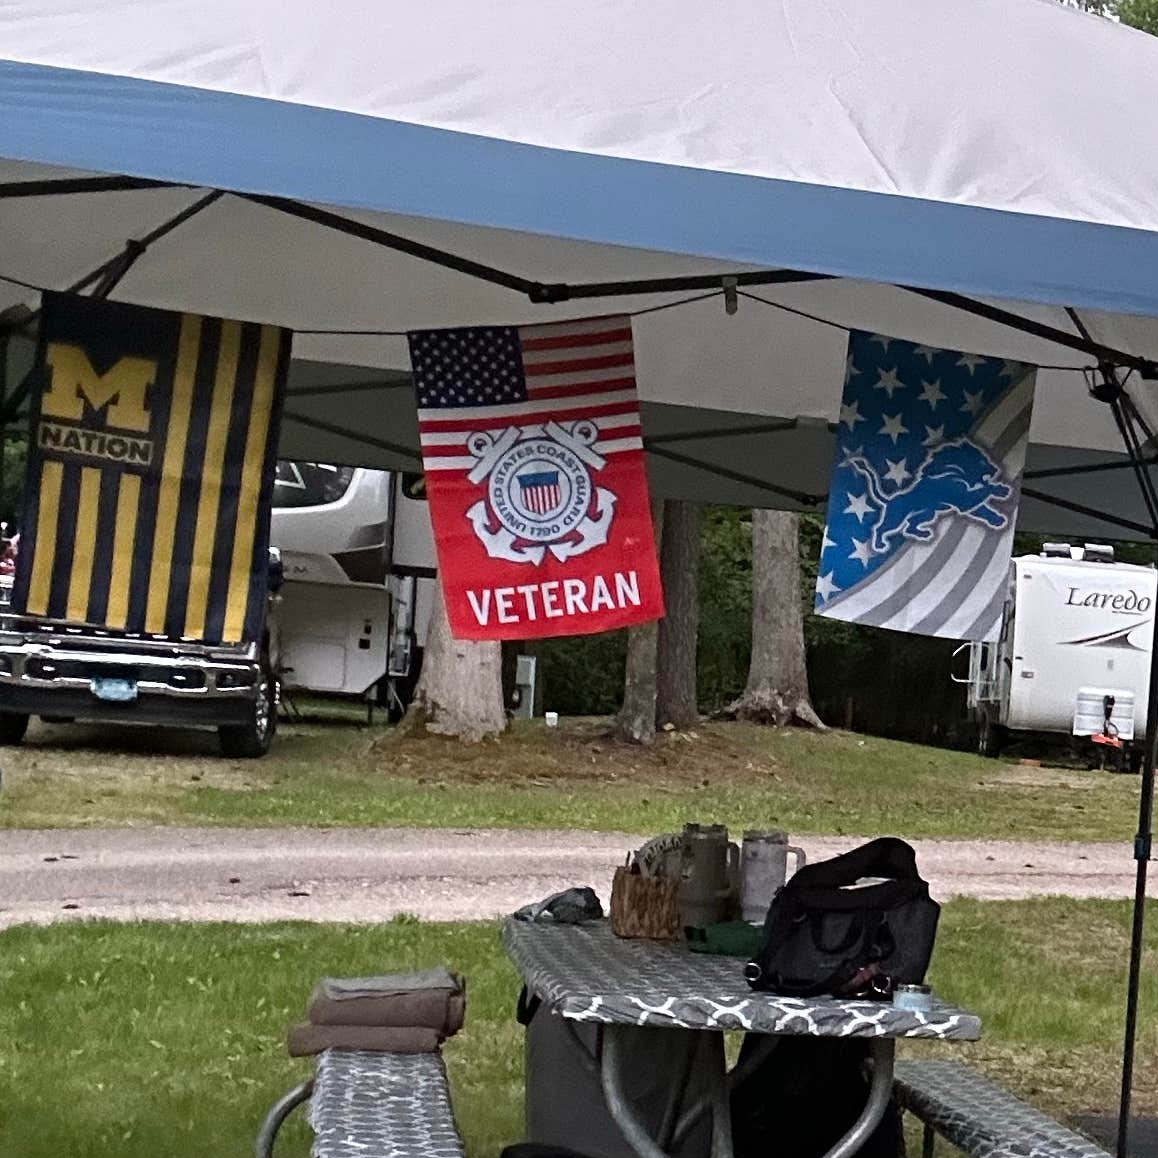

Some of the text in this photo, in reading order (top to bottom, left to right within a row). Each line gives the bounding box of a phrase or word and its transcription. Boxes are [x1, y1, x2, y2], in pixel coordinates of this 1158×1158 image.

[42, 344, 158, 433] M
[41, 425, 152, 464] NATION
[494, 444, 587, 532] UNITED STATES COAST GUARD
[529, 524, 561, 537] 1790
[465, 570, 641, 626] VETERAN
[1064, 587, 1152, 612] Laredo
